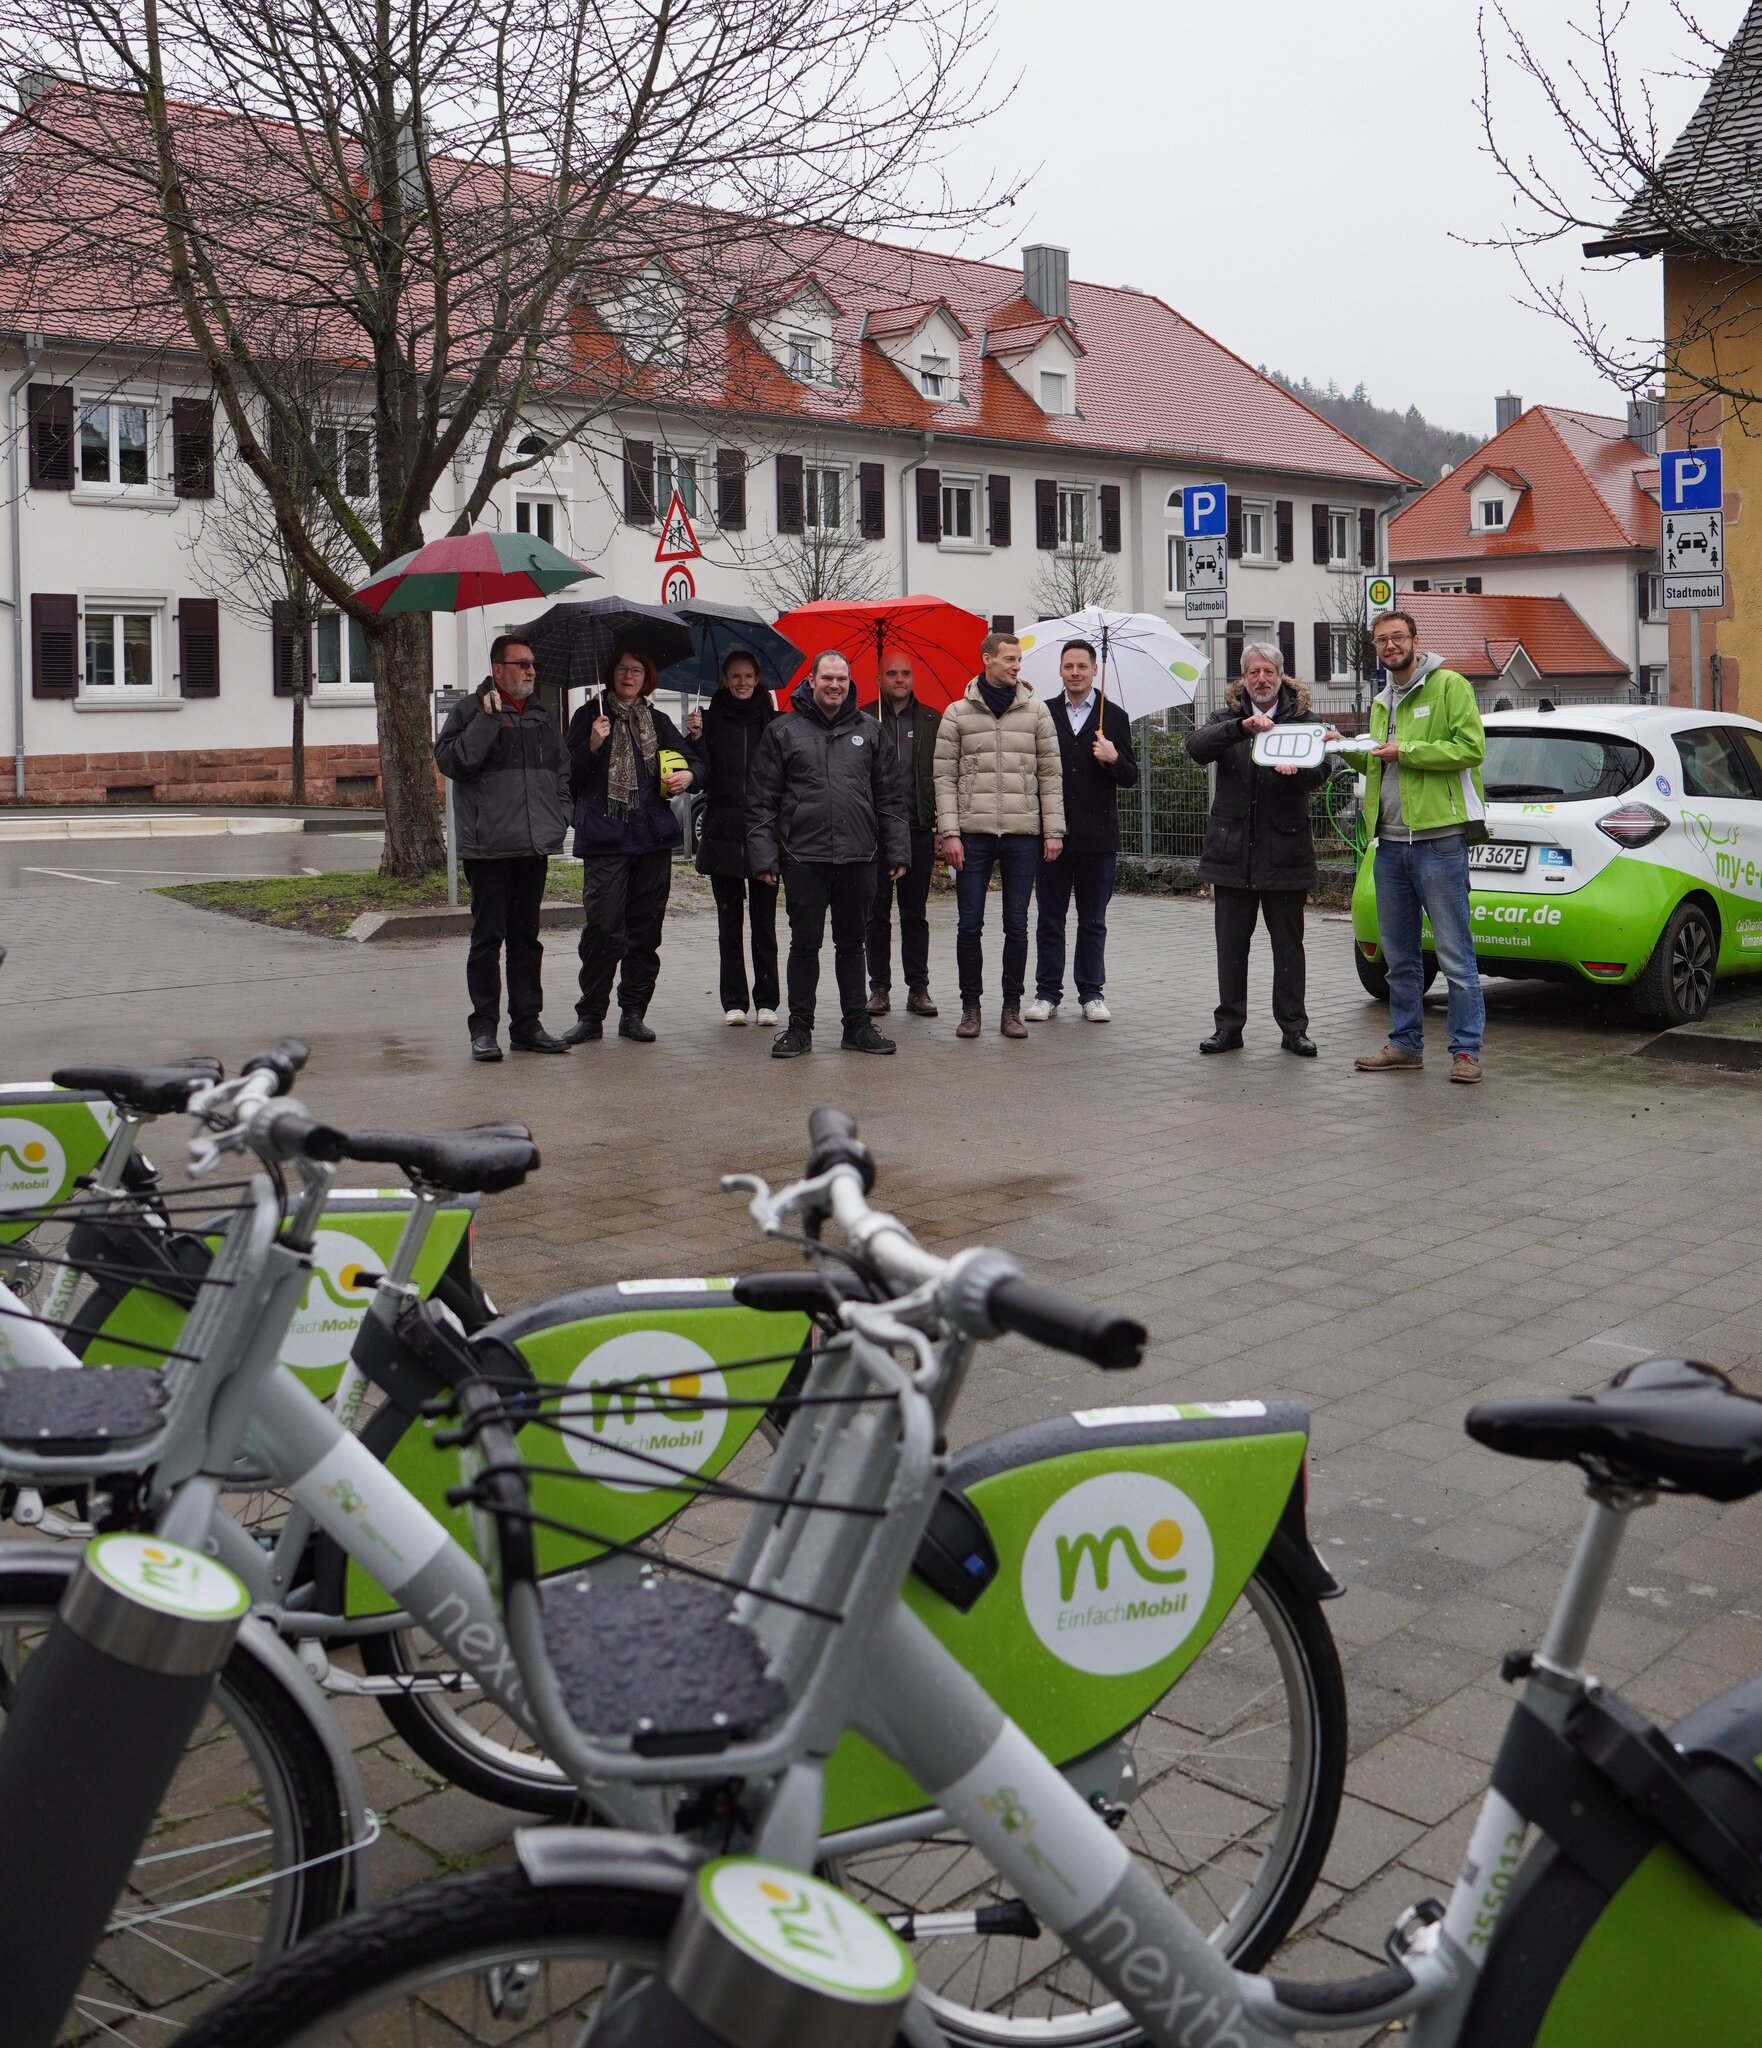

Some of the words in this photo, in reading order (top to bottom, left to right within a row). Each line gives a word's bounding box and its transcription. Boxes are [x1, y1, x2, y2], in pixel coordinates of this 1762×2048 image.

[1675, 457, 1707, 503] P
[1193, 492, 1216, 531] P
[668, 580, 688, 604] 30
[1666, 585, 1720, 599] Stadtmobil
[1187, 600, 1225, 612] Stadtmobil
[1485, 847, 1524, 865] 367E
[1716, 851, 1762, 889] my-e-
[1470, 904, 1562, 925] -e-car.de
[1472, 932, 1531, 947] imaneutral
[1056, 1593, 1187, 1632] EinfachMobil
